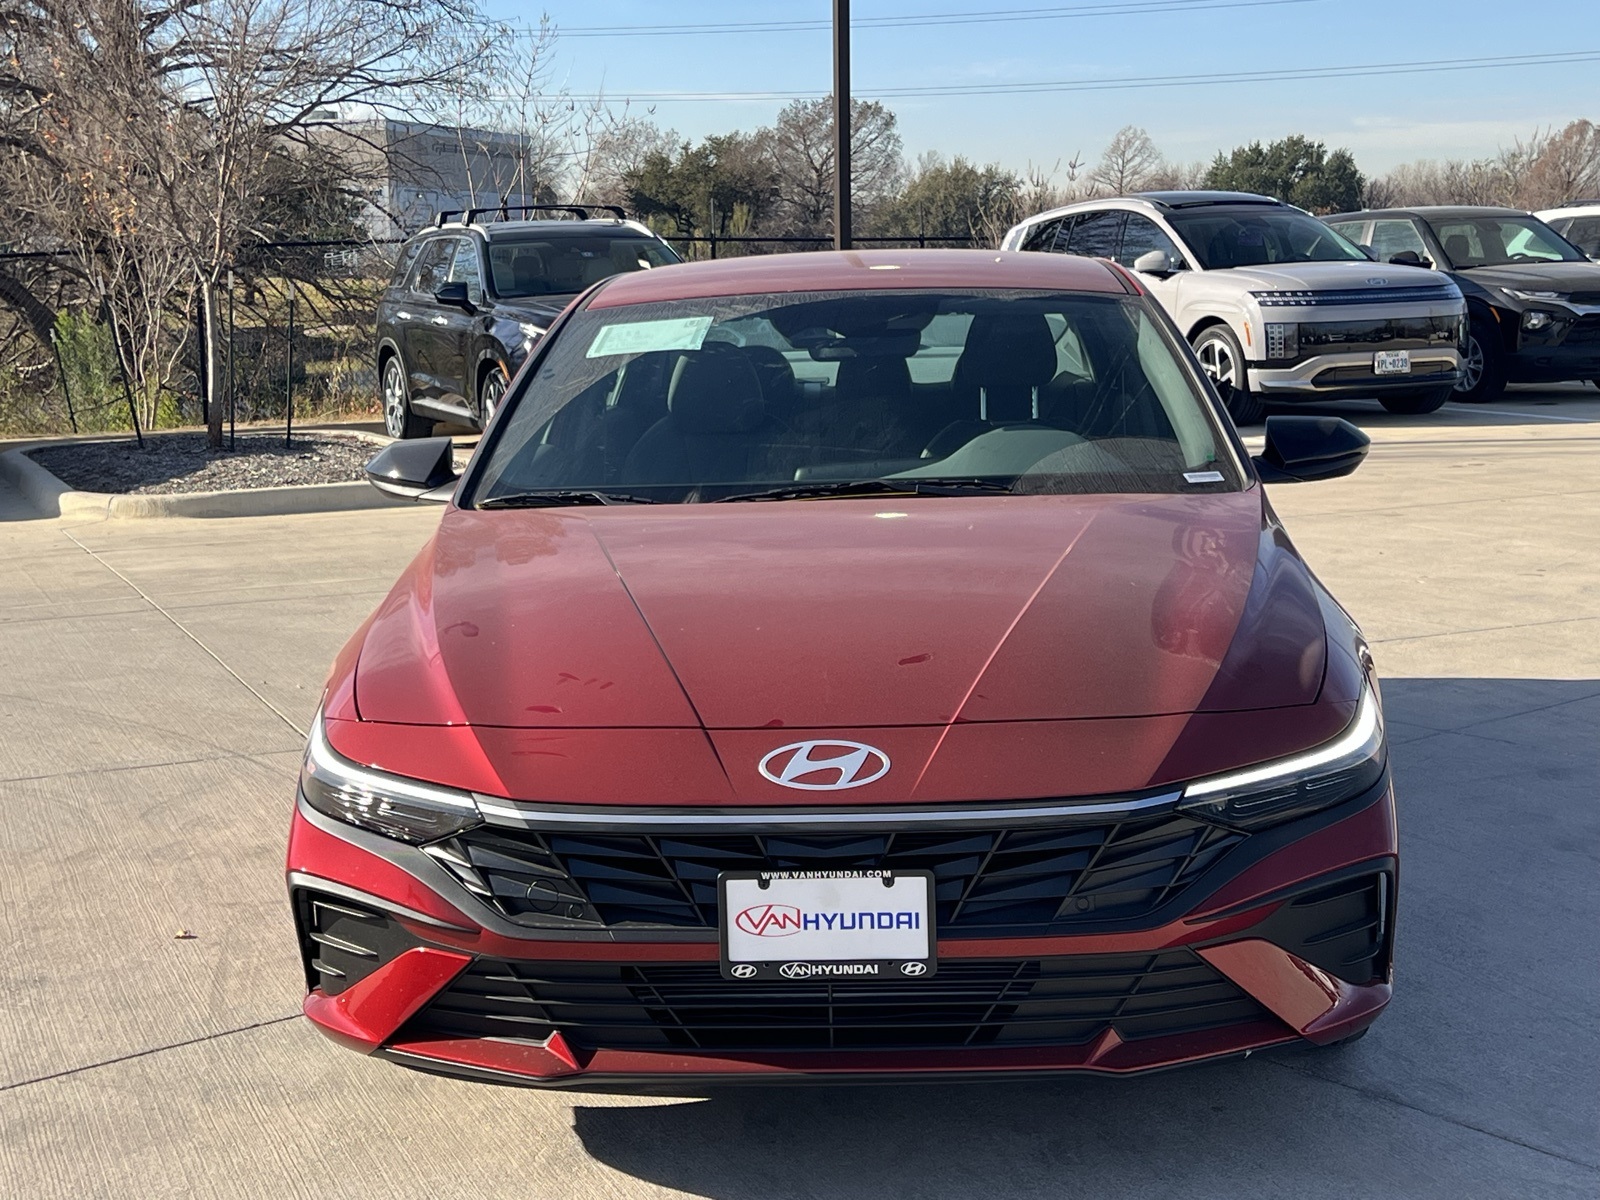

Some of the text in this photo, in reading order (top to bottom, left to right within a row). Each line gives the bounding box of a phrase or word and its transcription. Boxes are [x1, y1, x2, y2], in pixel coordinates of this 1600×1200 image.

[761, 870, 892, 880] WWW.VANHYUNDAI.COM
[740, 904, 920, 936] VAN HYUNDAI
[781, 962, 879, 978] VAN HYUNDAI
